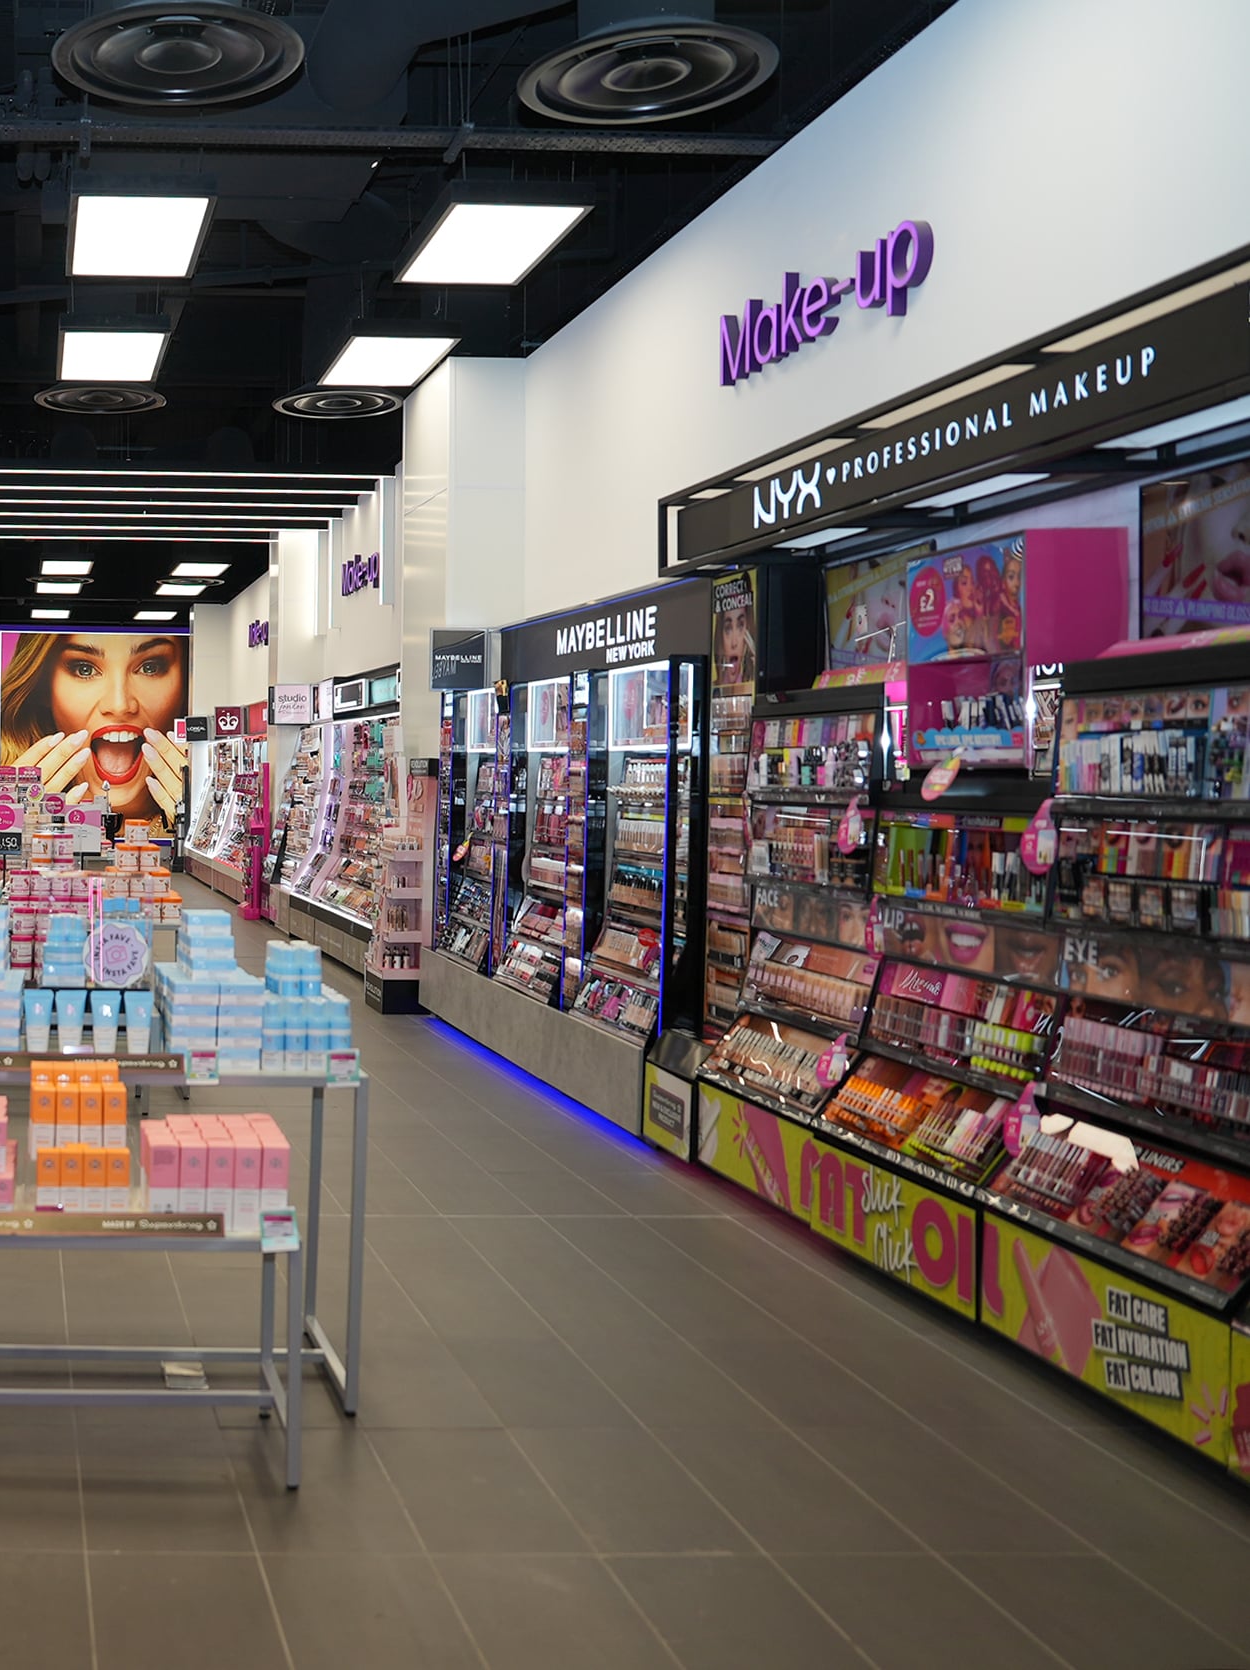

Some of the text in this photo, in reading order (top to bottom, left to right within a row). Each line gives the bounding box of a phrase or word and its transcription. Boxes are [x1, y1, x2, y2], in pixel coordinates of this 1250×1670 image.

[720, 220, 934, 386] Make-up
[753, 346, 1155, 529] NYX PROFESSIONAL MAKEUP
[341, 551, 380, 597] Make-up
[715, 580, 744, 599] CORRECT
[722, 592, 752, 611] CONCEAL
[920, 588, 935, 613] £2
[556, 605, 658, 656] MAYBELLINE
[606, 640, 655, 664] NEW YORK
[278, 694, 307, 703] studio
[755, 887, 779, 908] FACE
[884, 909, 905, 930] LIP
[1064, 936, 1098, 965] EYE
[1139, 1148, 1185, 1174] LINERS
[1108, 1290, 1166, 1332] FAT CARE
[1093, 1323, 1187, 1370] FAT HYDRATION
[1106, 1360, 1180, 1397] FAT COLOUR
